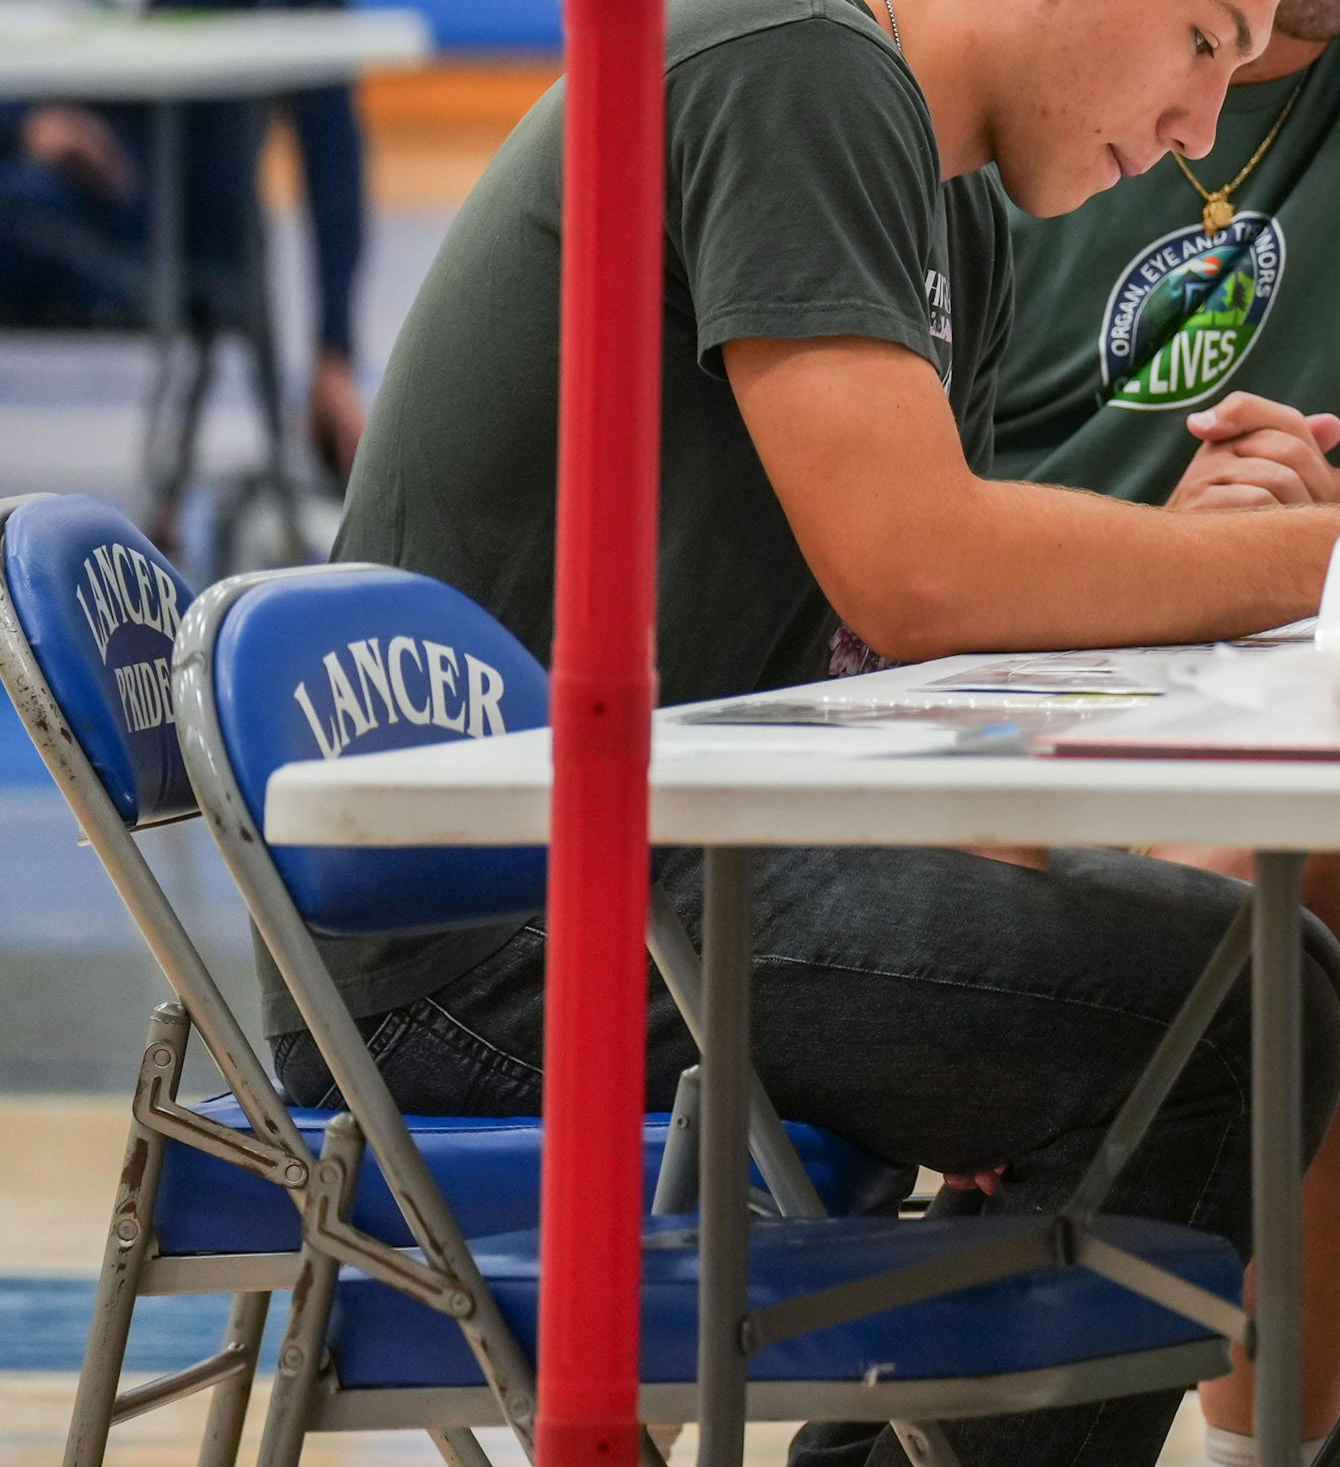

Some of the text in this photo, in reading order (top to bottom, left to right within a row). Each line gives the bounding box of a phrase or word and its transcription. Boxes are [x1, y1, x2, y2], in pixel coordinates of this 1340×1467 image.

[1140, 246, 1182, 284] EYE
[1182, 229, 1228, 259] AND
[1149, 329, 1238, 395] LIVES
[76, 542, 183, 667] LANCER
[114, 657, 177, 733] PRIDE
[294, 635, 507, 761] LANCER
